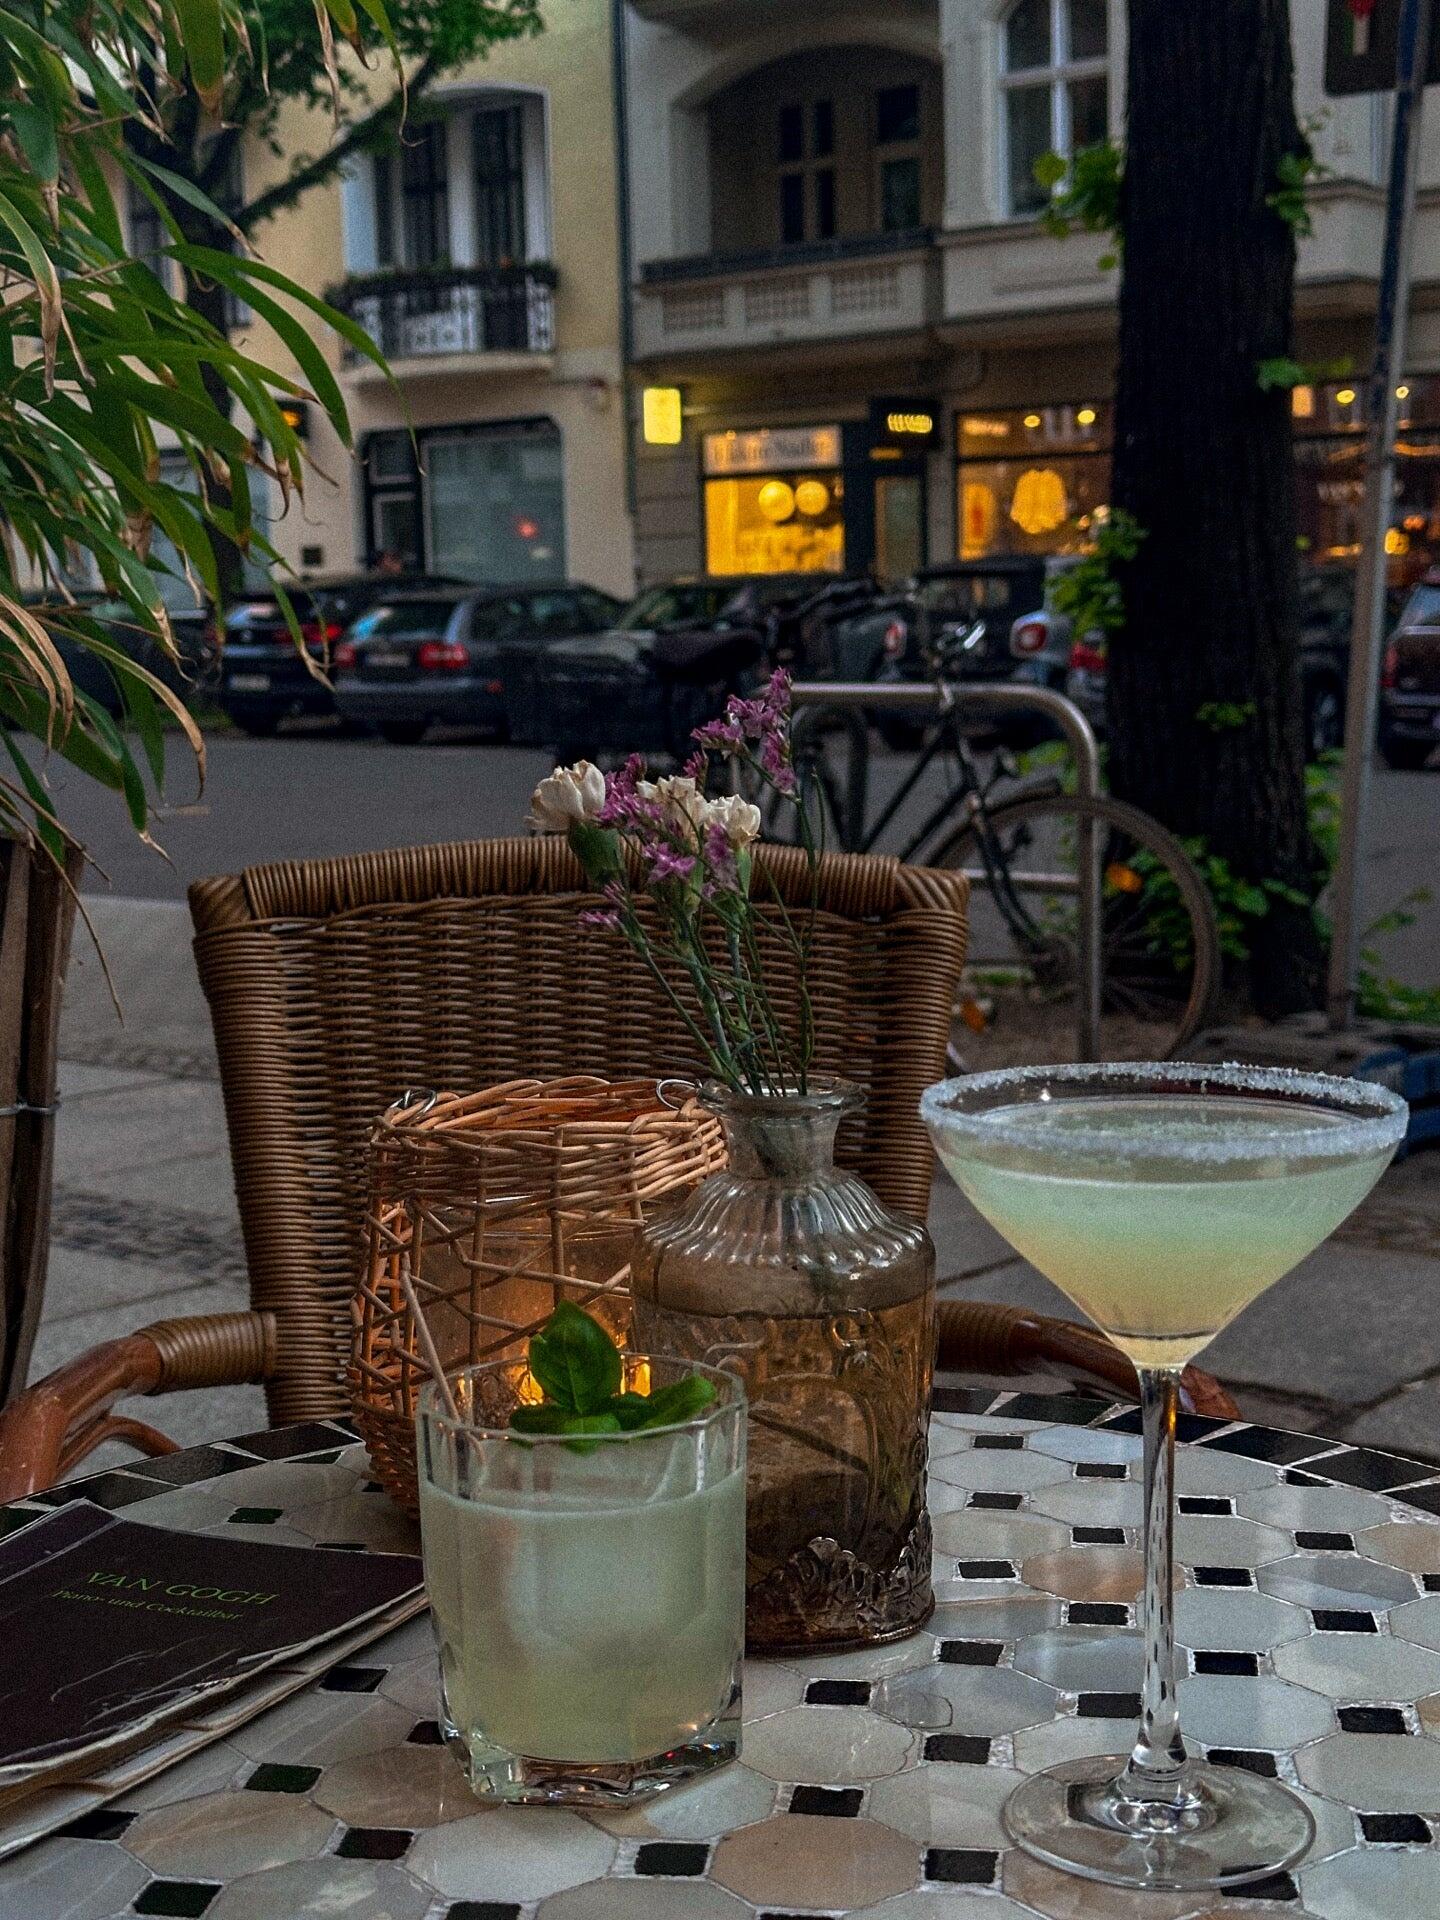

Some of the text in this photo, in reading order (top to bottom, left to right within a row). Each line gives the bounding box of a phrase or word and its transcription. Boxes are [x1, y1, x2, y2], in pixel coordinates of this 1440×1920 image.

[87, 1572, 280, 1605] VAN GOGH
[108, 1597, 145, 1609] und
[146, 1601, 244, 1621] Cocktailbar
